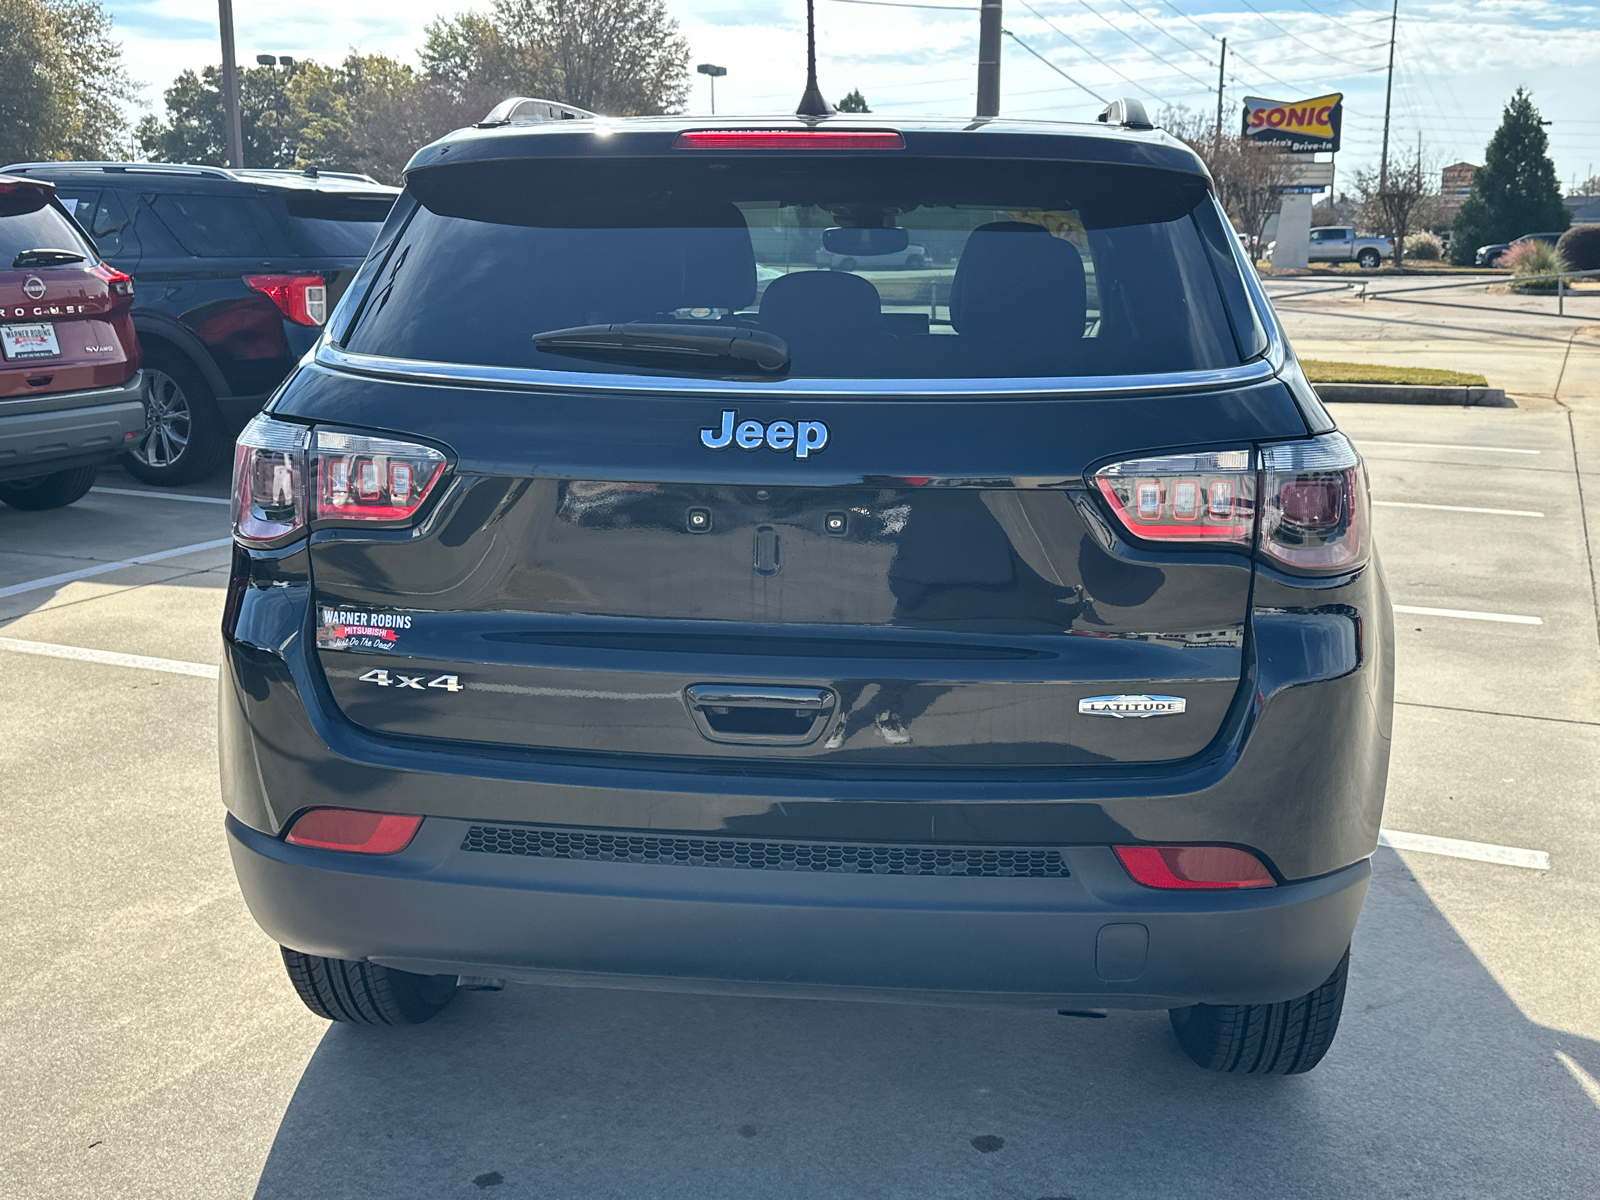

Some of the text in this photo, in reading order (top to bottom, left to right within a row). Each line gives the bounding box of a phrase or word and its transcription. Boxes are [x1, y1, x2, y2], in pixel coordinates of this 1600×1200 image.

[1250, 106, 1333, 128] SONIC
[1248, 138, 1333, 151] America's Drive-In
[5, 328, 51, 339] WARNER ROBINS
[700, 411, 828, 458] Jeep
[324, 610, 412, 629] WARNER ROBINS
[344, 626, 387, 637] MITSUBISHI
[333, 637, 395, 651] Just Do The Deal!
[358, 668, 464, 692] 4x4
[1090, 703, 1176, 711] LATITUDE
